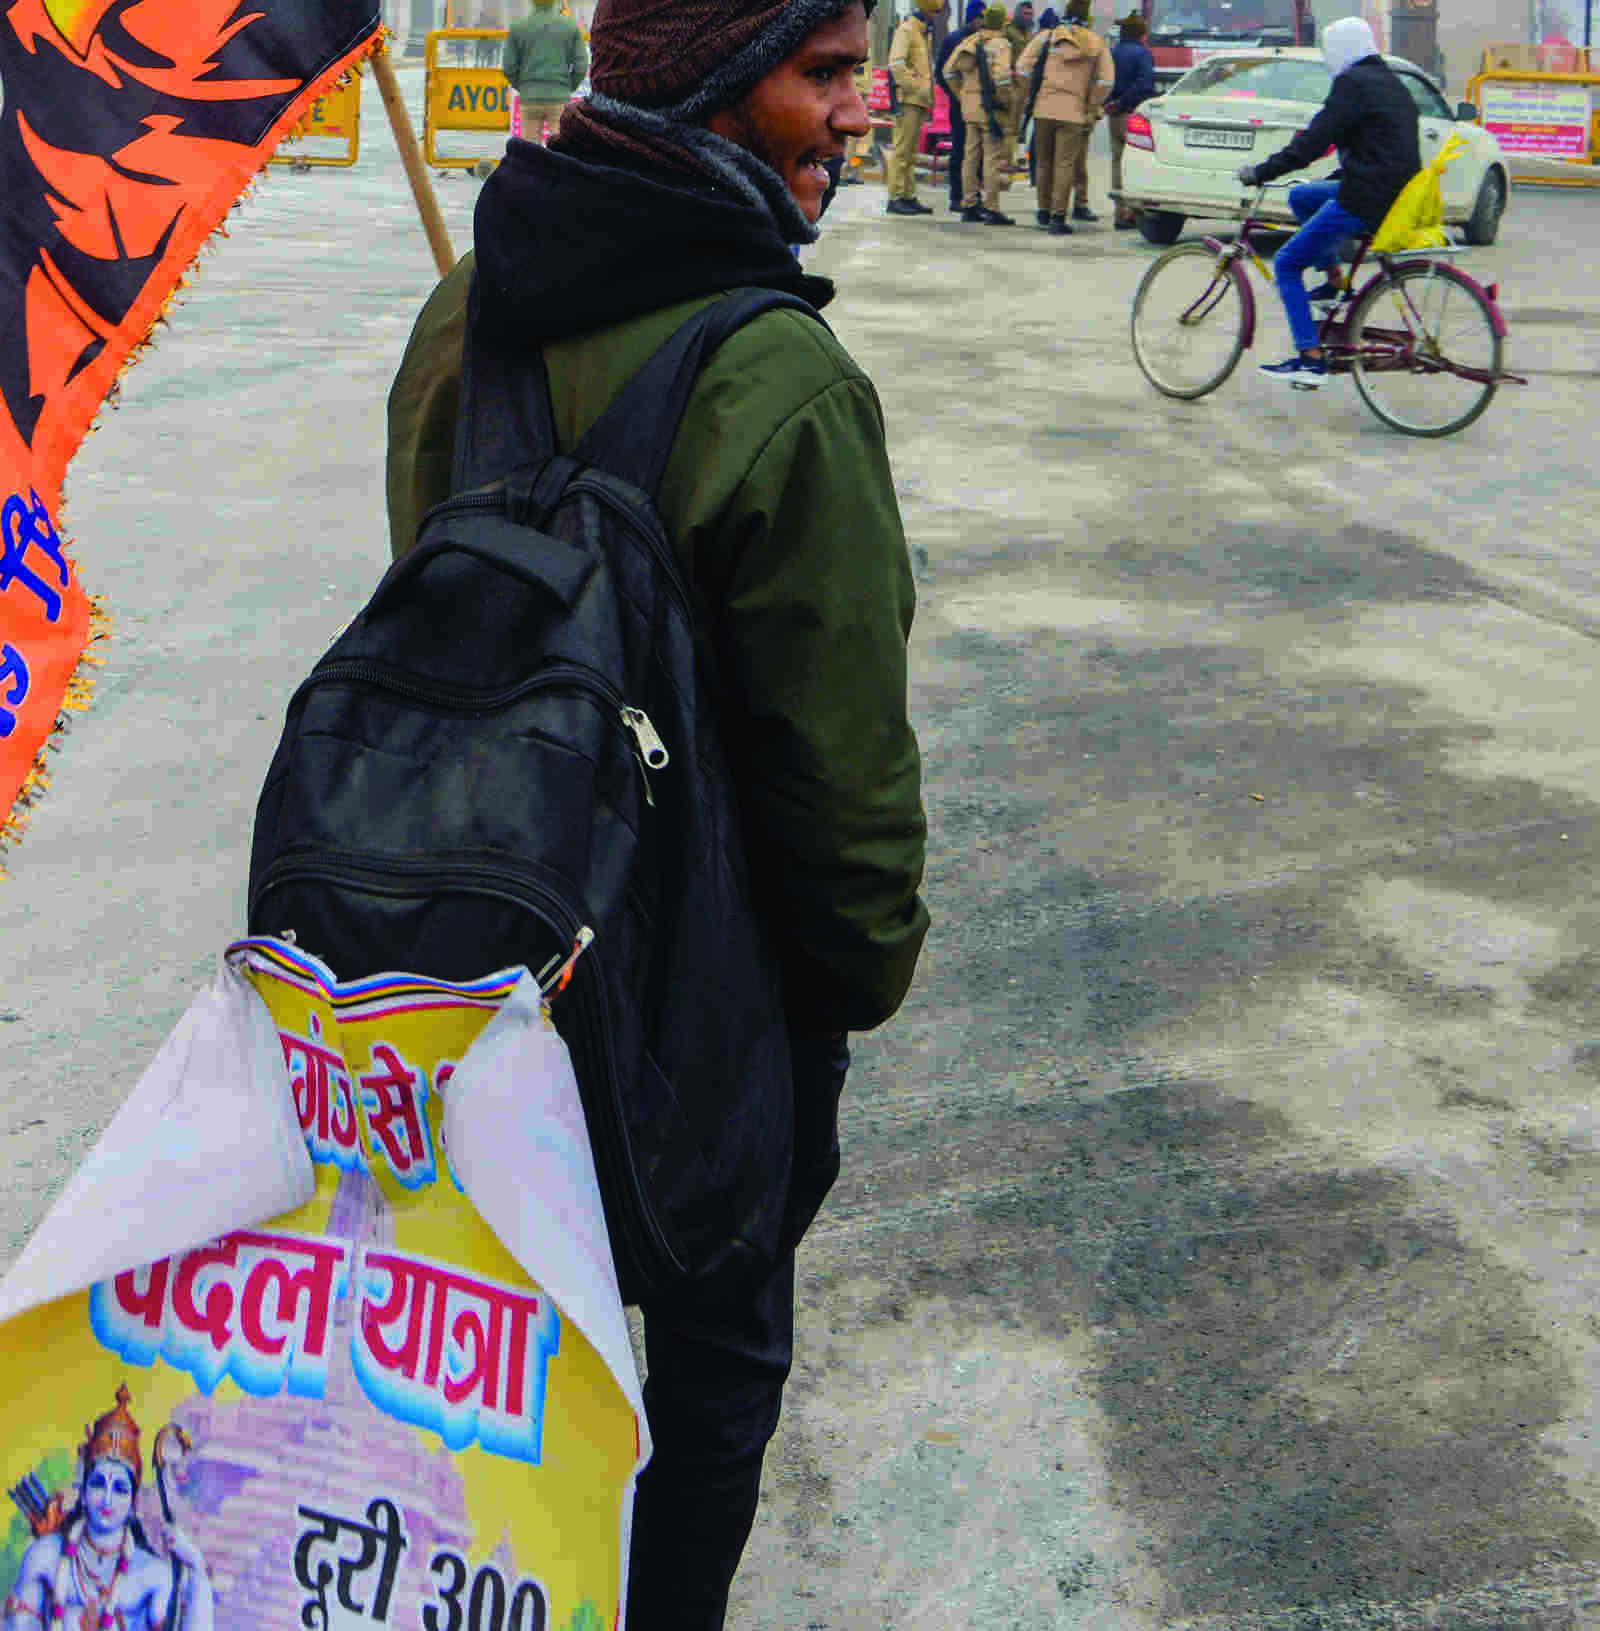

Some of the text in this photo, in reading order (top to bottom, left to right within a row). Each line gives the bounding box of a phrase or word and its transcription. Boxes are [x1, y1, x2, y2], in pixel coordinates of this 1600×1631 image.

[447, 83, 512, 113] AYOD
[358, 1043, 426, 1172] से
[113, 1229, 538, 1417] पदल यात्रा
[293, 1497, 408, 1631] दूरी
